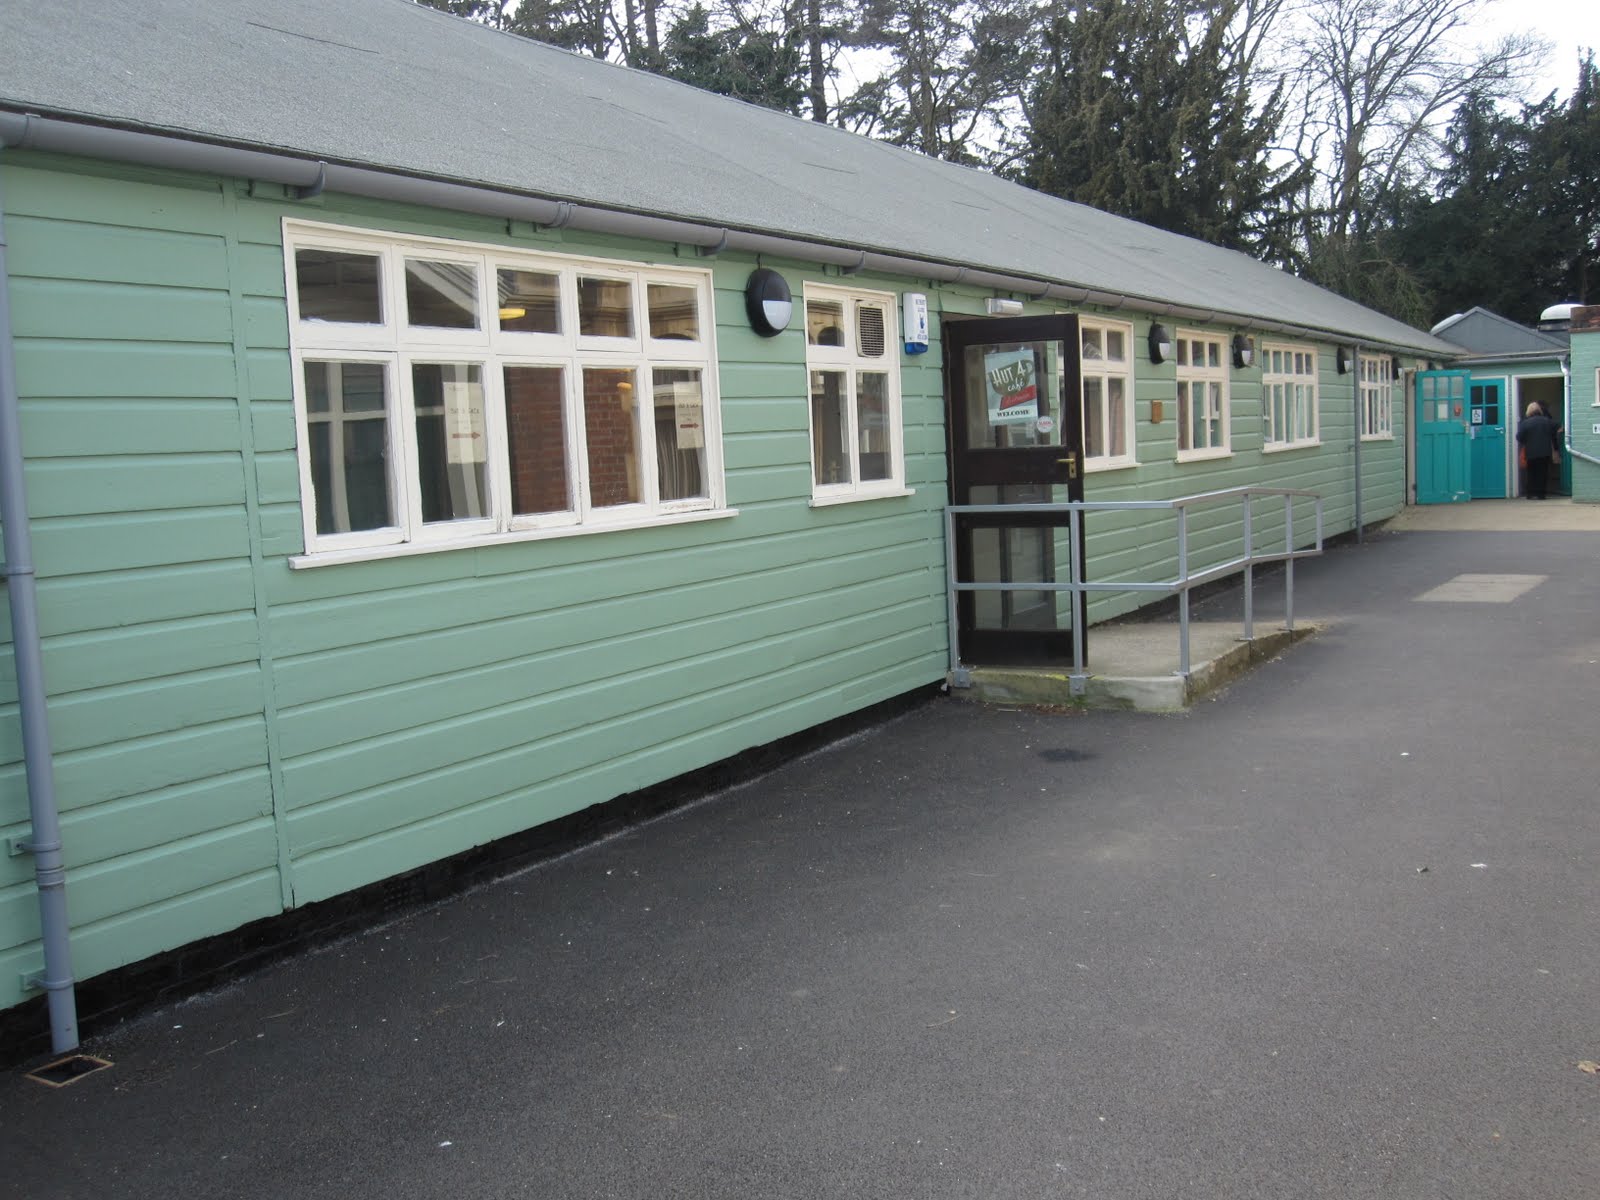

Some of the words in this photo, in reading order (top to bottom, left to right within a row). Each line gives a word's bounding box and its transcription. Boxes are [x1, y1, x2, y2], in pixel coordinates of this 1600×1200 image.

[992, 367, 1014, 387] HUT
[1017, 360, 1026, 377] 4
[997, 409, 1030, 418] WELCOME
